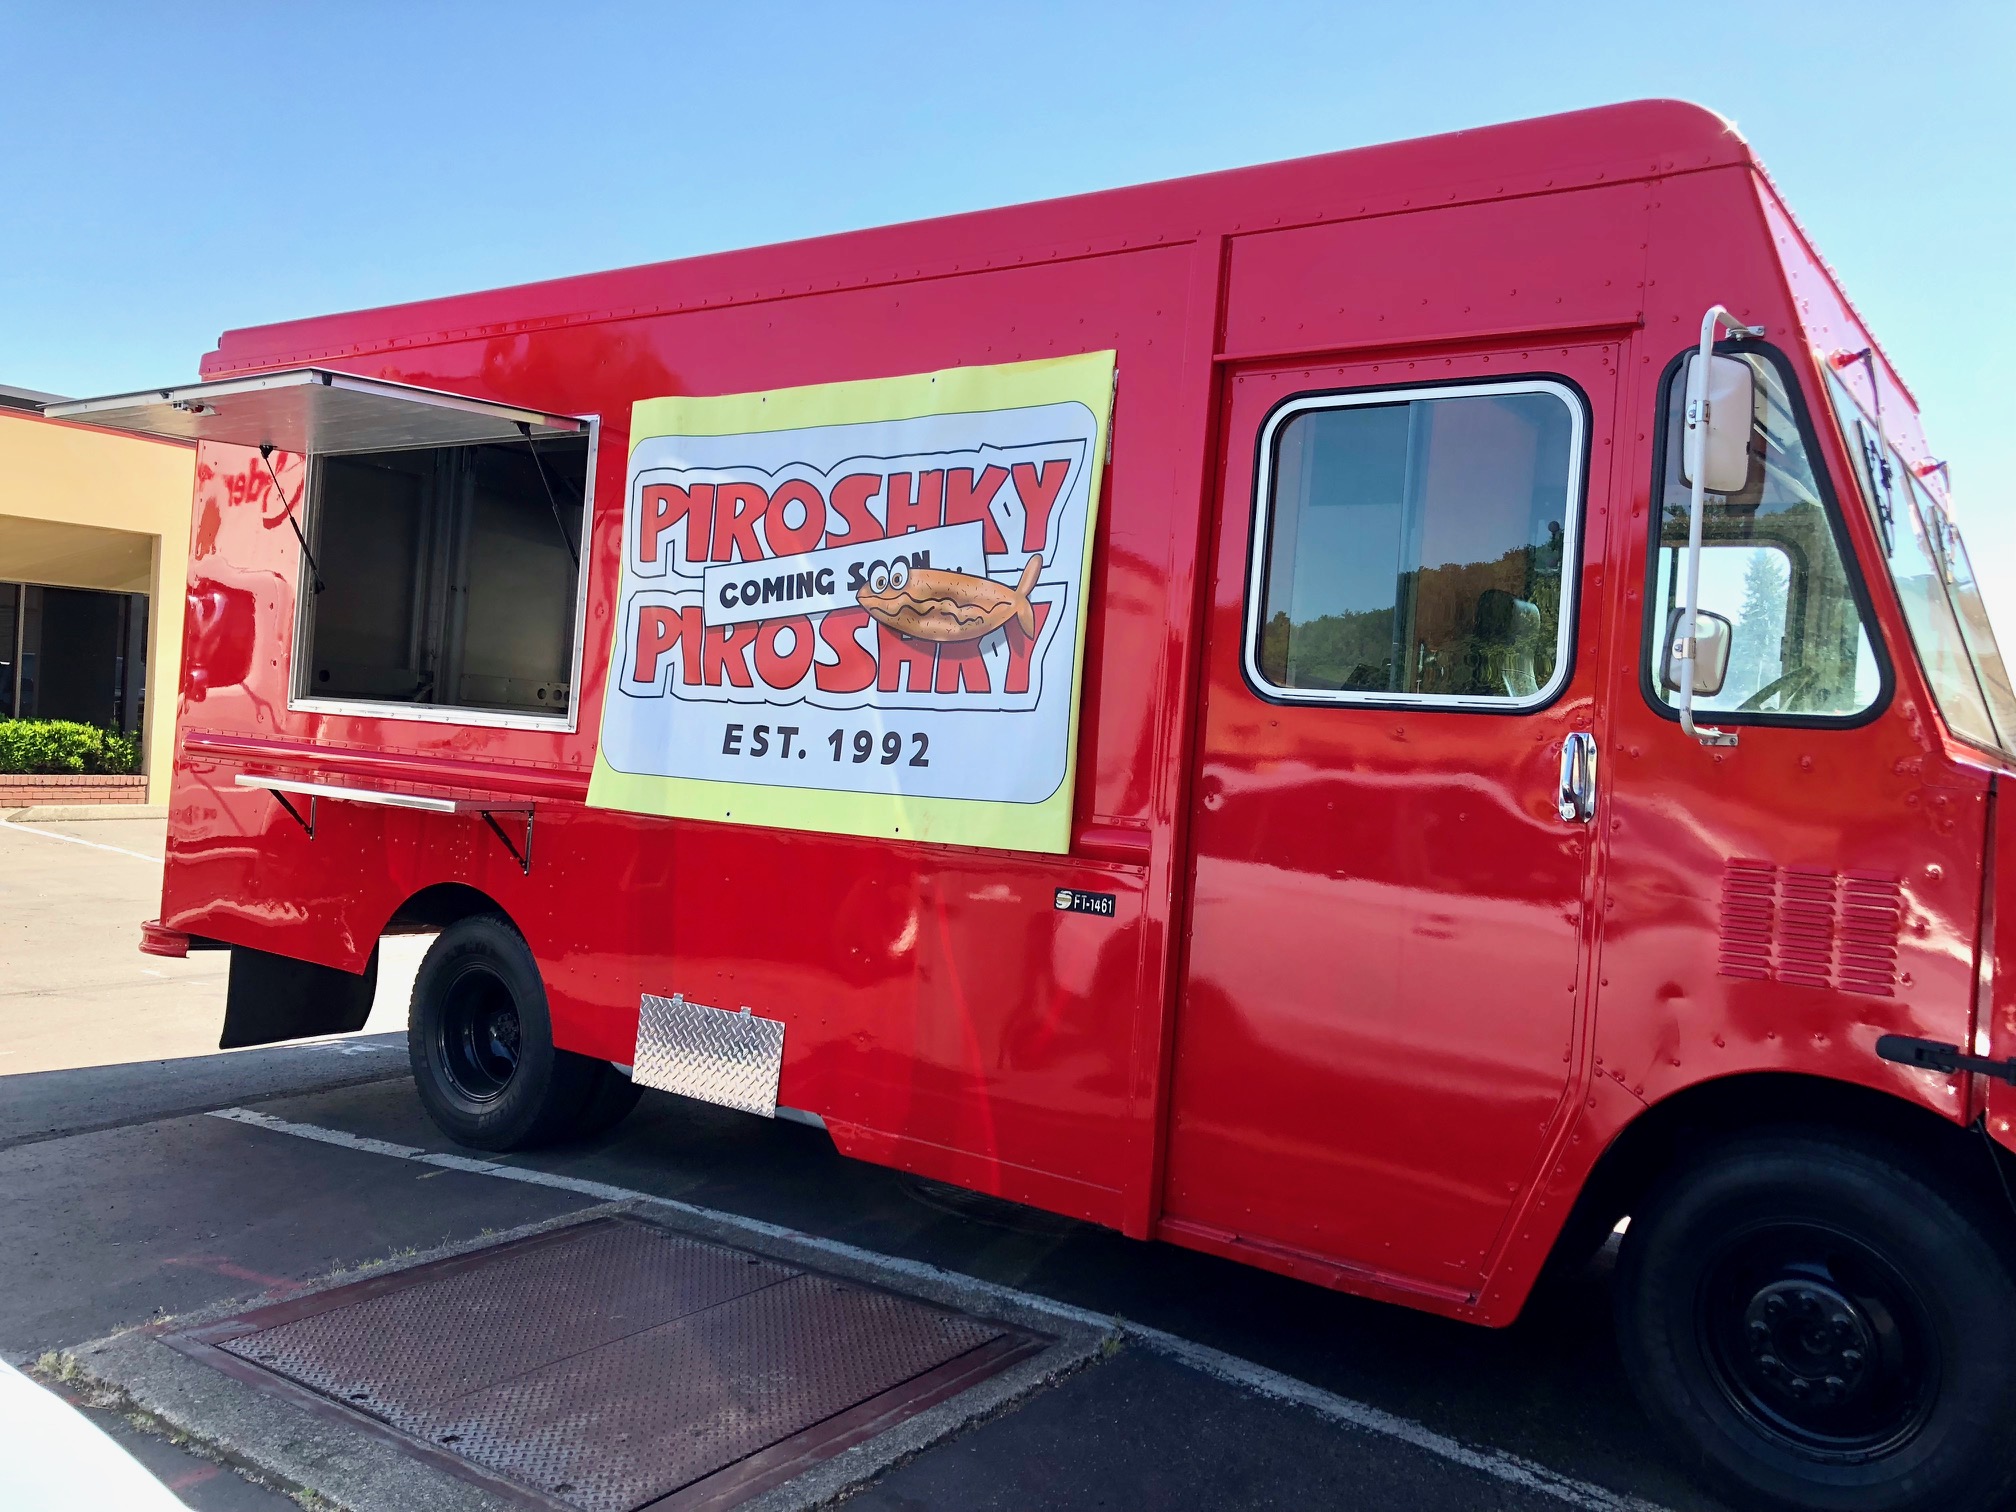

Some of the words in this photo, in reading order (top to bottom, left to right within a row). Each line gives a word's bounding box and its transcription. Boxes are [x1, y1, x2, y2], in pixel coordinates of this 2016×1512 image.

[640, 459, 1071, 563] PIROSHKY
[719, 569, 835, 608] COMING
[846, 550, 931, 592] SN
[722, 724, 806, 759] EST.
[827, 729, 930, 767] 1992
